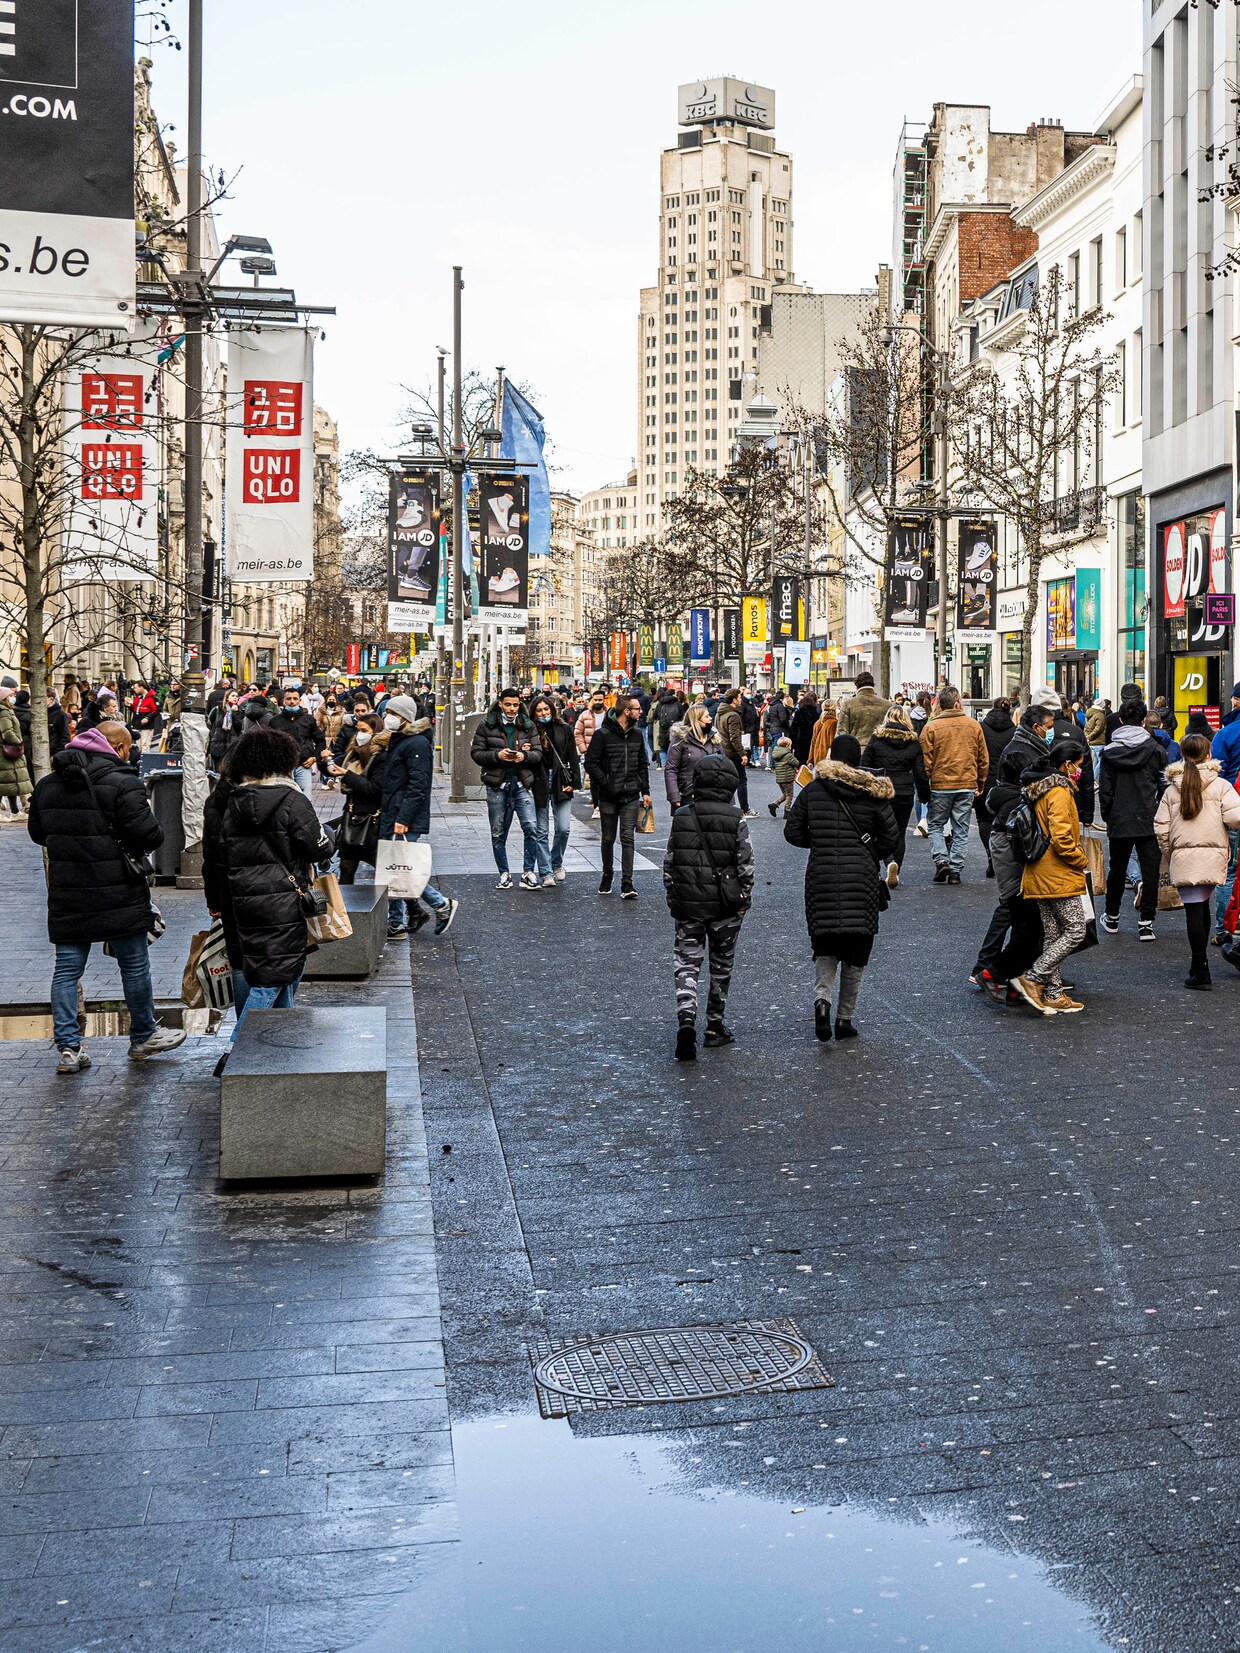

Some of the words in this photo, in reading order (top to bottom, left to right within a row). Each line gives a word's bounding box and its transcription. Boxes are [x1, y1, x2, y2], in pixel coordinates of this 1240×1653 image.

[686, 104, 716, 120] KBC
[734, 104, 769, 123] KBC
[249, 456, 291, 475] UNI
[249, 478, 294, 500] QLO
[398, 532, 417, 542] AM
[489, 536, 506, 546] AM
[237, 558, 303, 570] meir-as.be
[1166, 557, 1182, 573] SOLDEN
[1182, 533, 1203, 600] JD
[896, 569, 910, 577] AM
[966, 571, 980, 579] AM
[780, 582, 792, 620] fnac
[750, 605, 758, 638] Panos
[1180, 673, 1204, 690] JD
[210, 963, 230, 976] Foot
